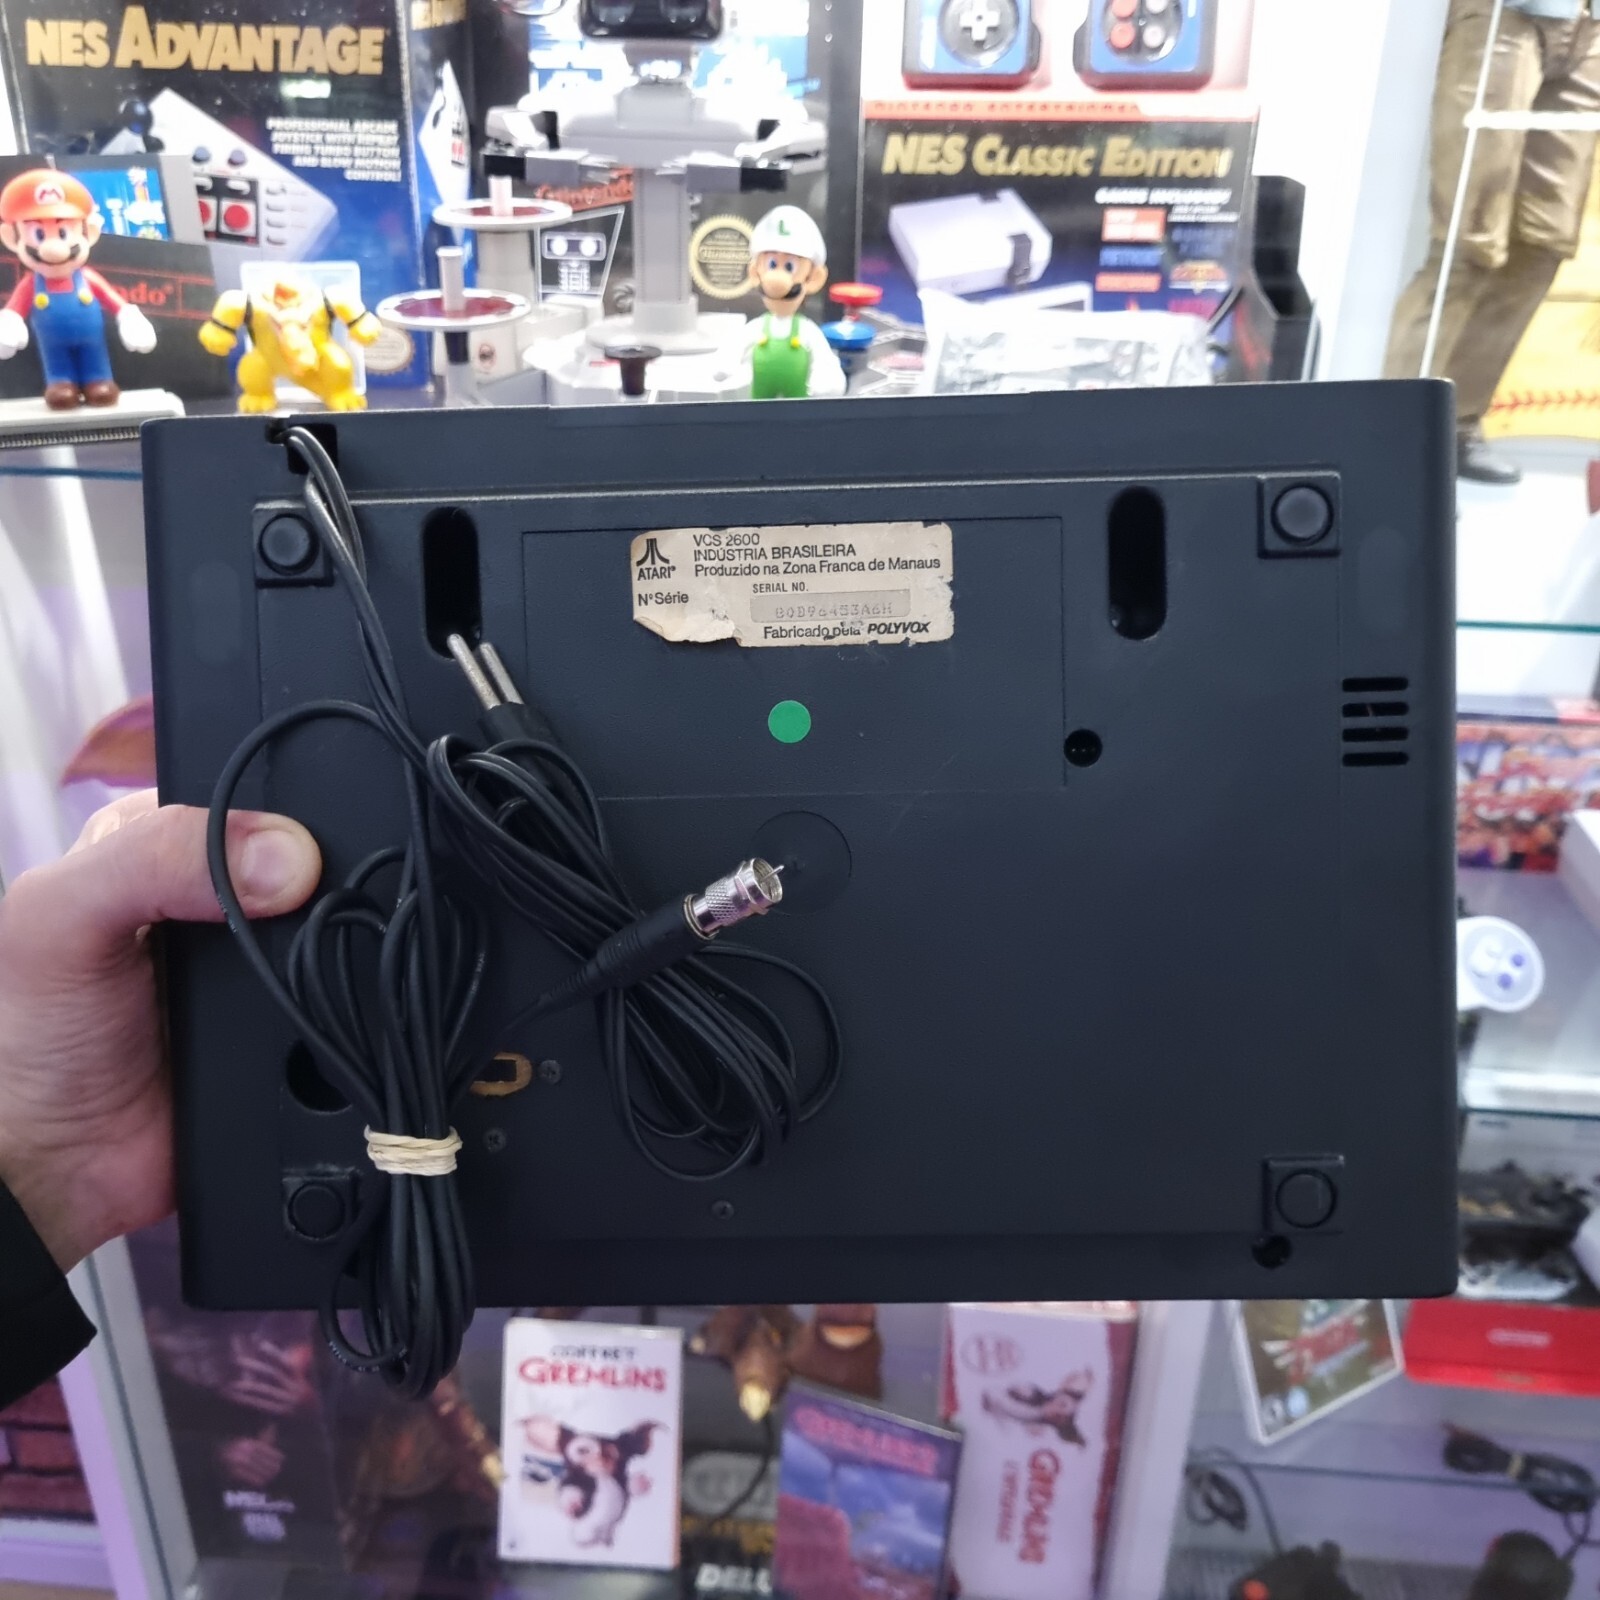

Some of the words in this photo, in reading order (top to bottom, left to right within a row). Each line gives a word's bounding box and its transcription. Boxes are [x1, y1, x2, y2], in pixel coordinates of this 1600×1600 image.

[26, 19, 110, 68] NES
[114, 5, 385, 75] ADVANTAGE
[881, 133, 968, 176] NES
[972, 134, 1095, 178] CLASSIC
[1100, 136, 1232, 179] EDITION
[778, 219, 790, 235] L
[693, 533, 722, 547] VCS
[725, 532, 760, 546] 2600
[694, 547, 768, 562] INDÚSTRIA
[771, 543, 857, 560] BRASILEIRA
[695, 562, 760, 577] Produzido
[763, 564, 779, 575] na
[783, 561, 816, 575] Zona
[819, 559, 865, 573] Franca
[868, 558, 885, 571] de
[888, 556, 941, 570] Manaus
[752, 583, 788, 594] SERIAL
[791, 581, 809, 592] NO.
[655, 591, 689, 605] Série
[763, 624, 830, 640] Fabricado
[867, 621, 931, 635] POLYVOX
[519, 1355, 666, 1393] GREMLINS
